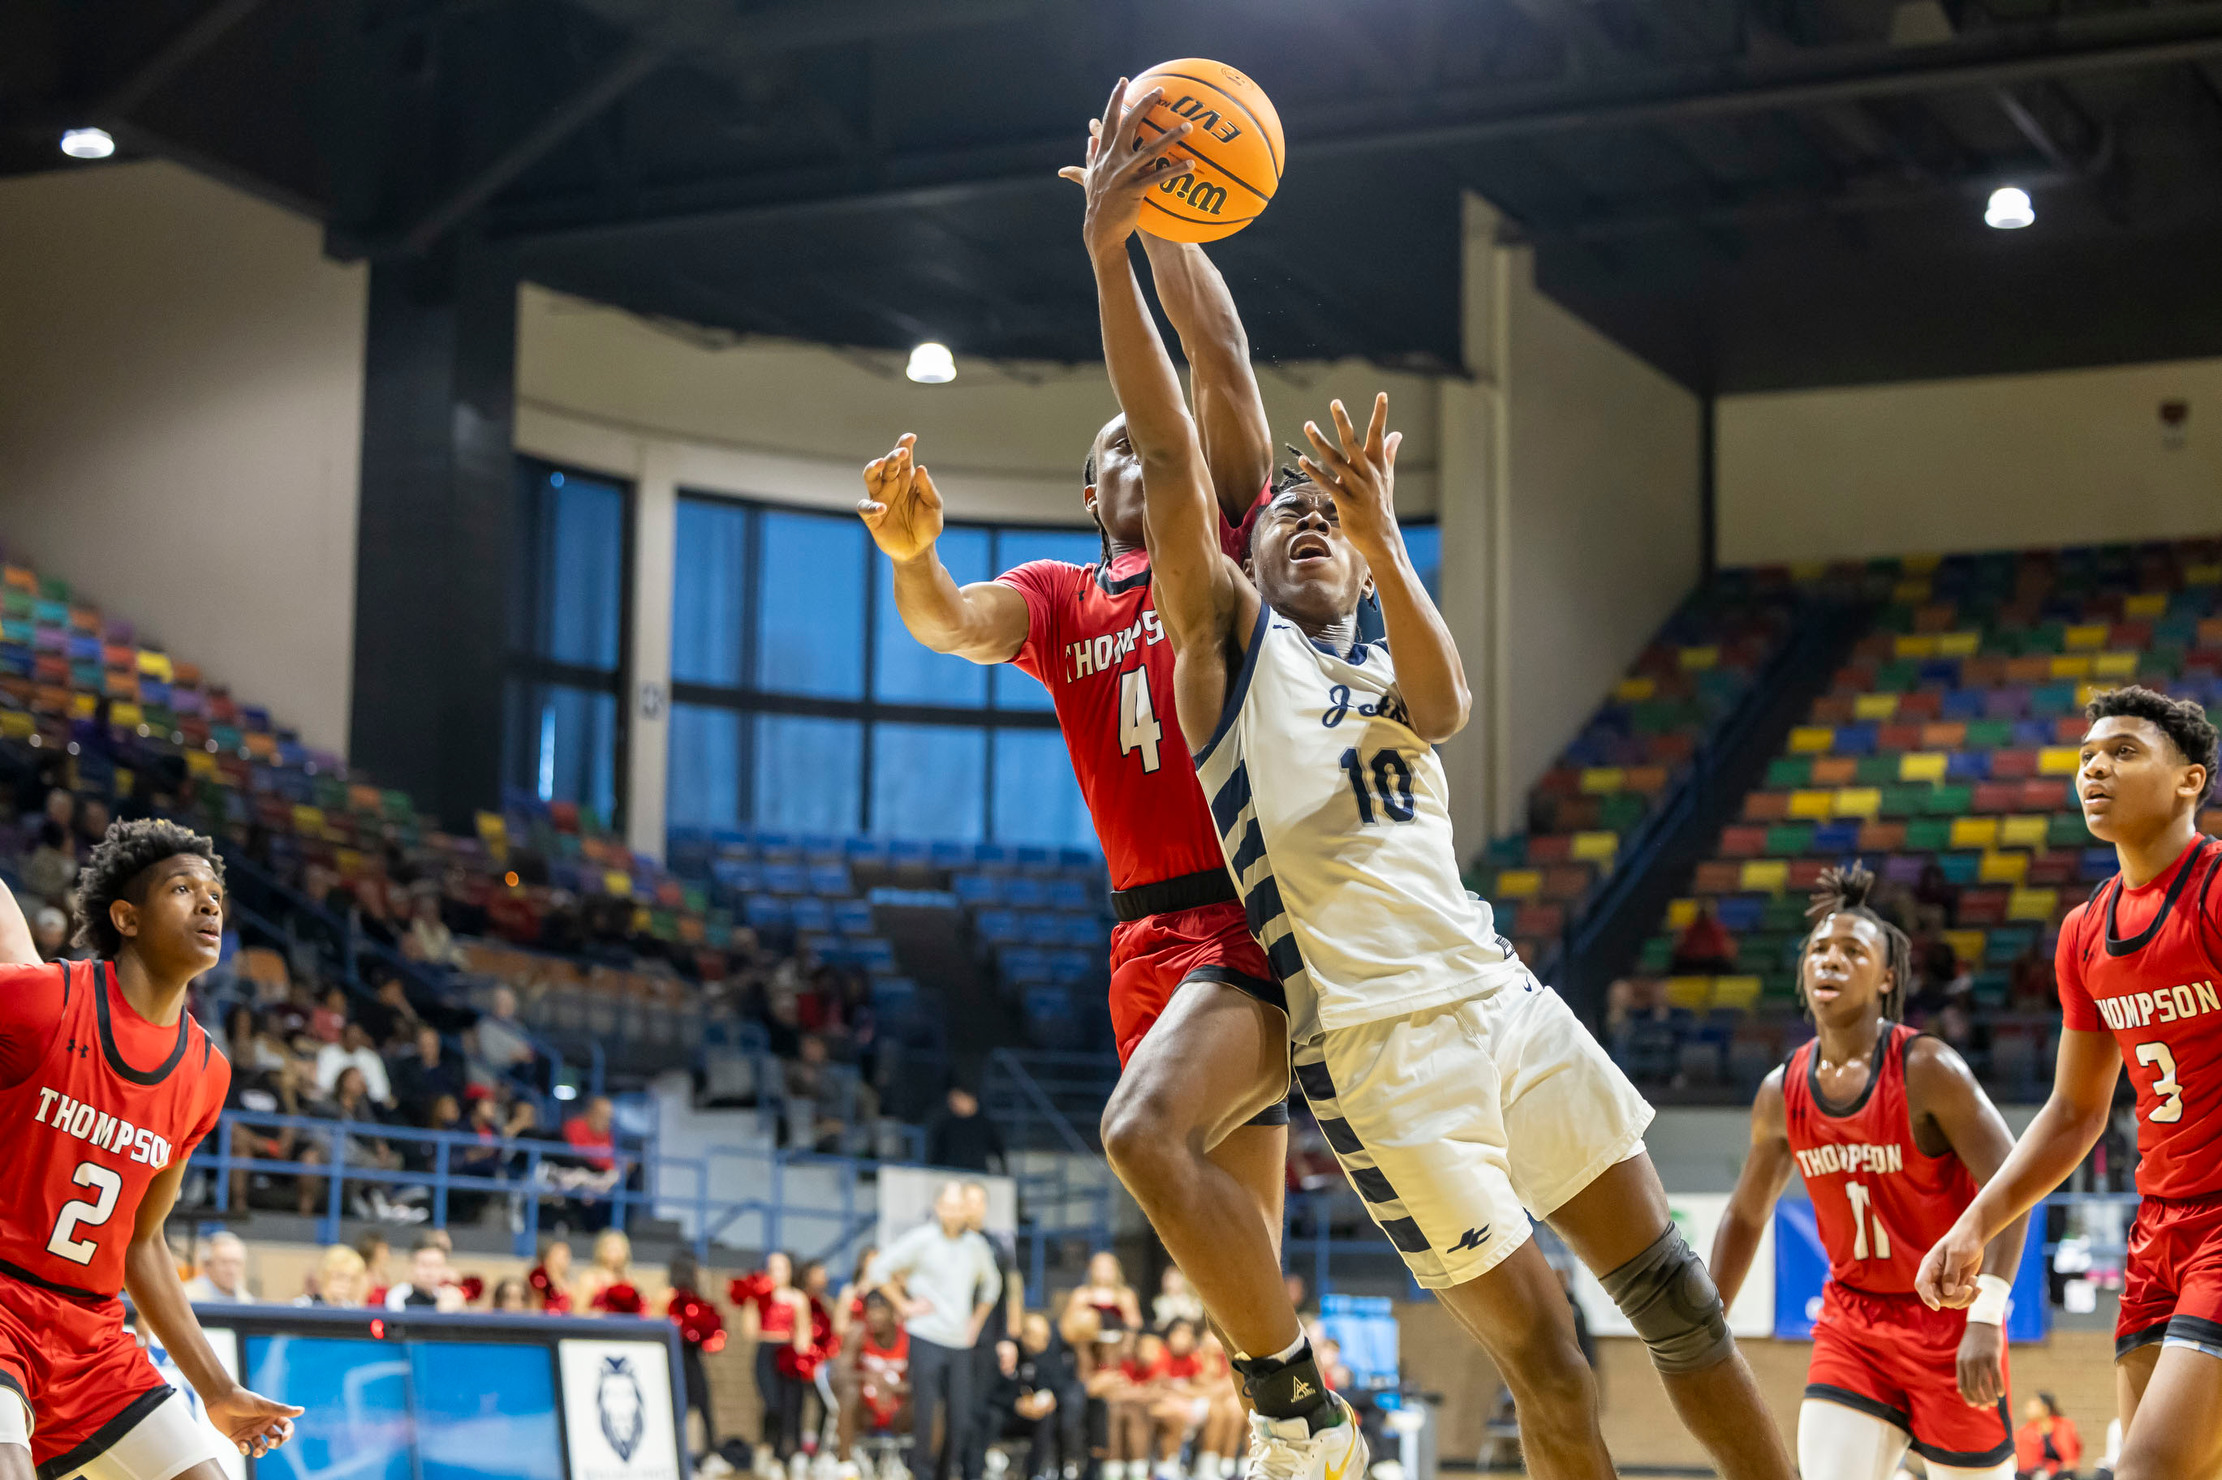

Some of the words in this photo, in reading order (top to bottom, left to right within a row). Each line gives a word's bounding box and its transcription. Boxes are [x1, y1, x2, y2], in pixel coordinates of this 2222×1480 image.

[1170, 96, 1241, 143] EVO
[1065, 609, 1166, 684] THOMPS
[1118, 663, 1163, 775] 4
[1337, 746, 1417, 828] 10
[2094, 979, 2222, 1031] HOMPSON
[2135, 1040, 2184, 1124] 3
[45, 1160, 123, 1267] 2
[1844, 1180, 1892, 1261] 11
